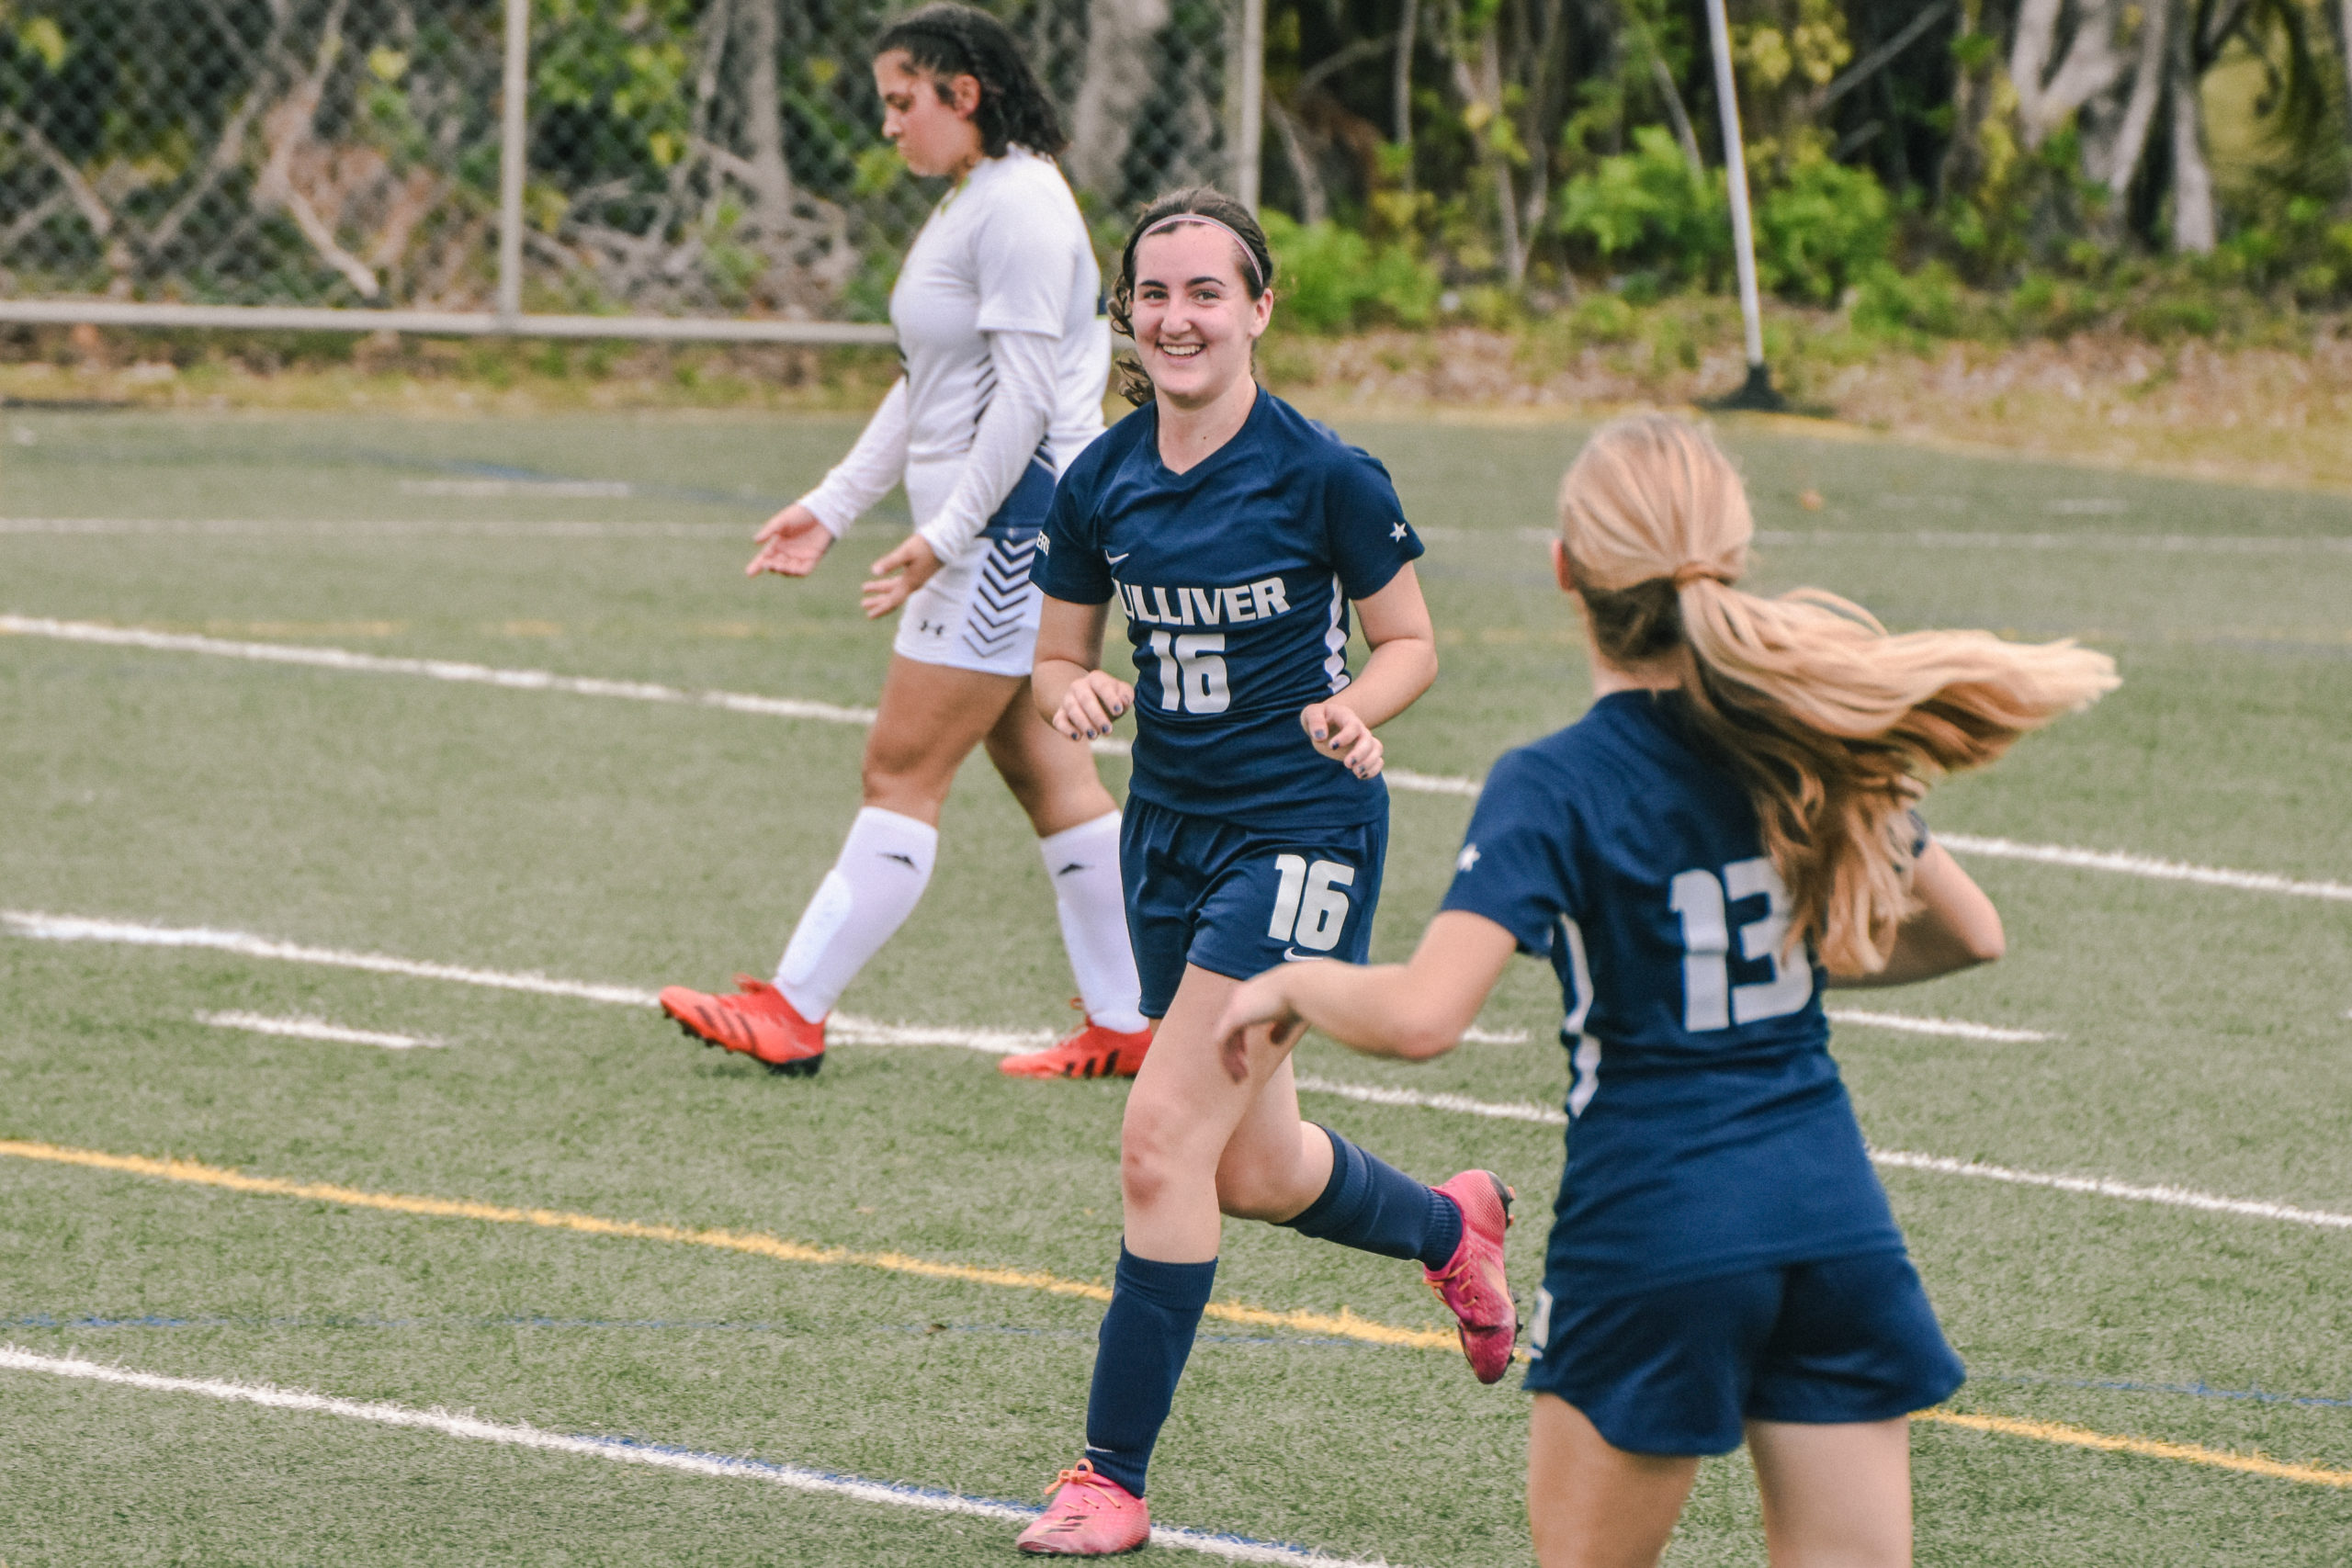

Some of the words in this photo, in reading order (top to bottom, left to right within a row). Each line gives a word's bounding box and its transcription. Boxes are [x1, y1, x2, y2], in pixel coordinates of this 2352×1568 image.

[1112, 577, 1290, 626] ULLIVER
[1149, 630, 1231, 714] 16
[1268, 853, 1354, 951] 16
[1668, 857, 1814, 1032] 13
